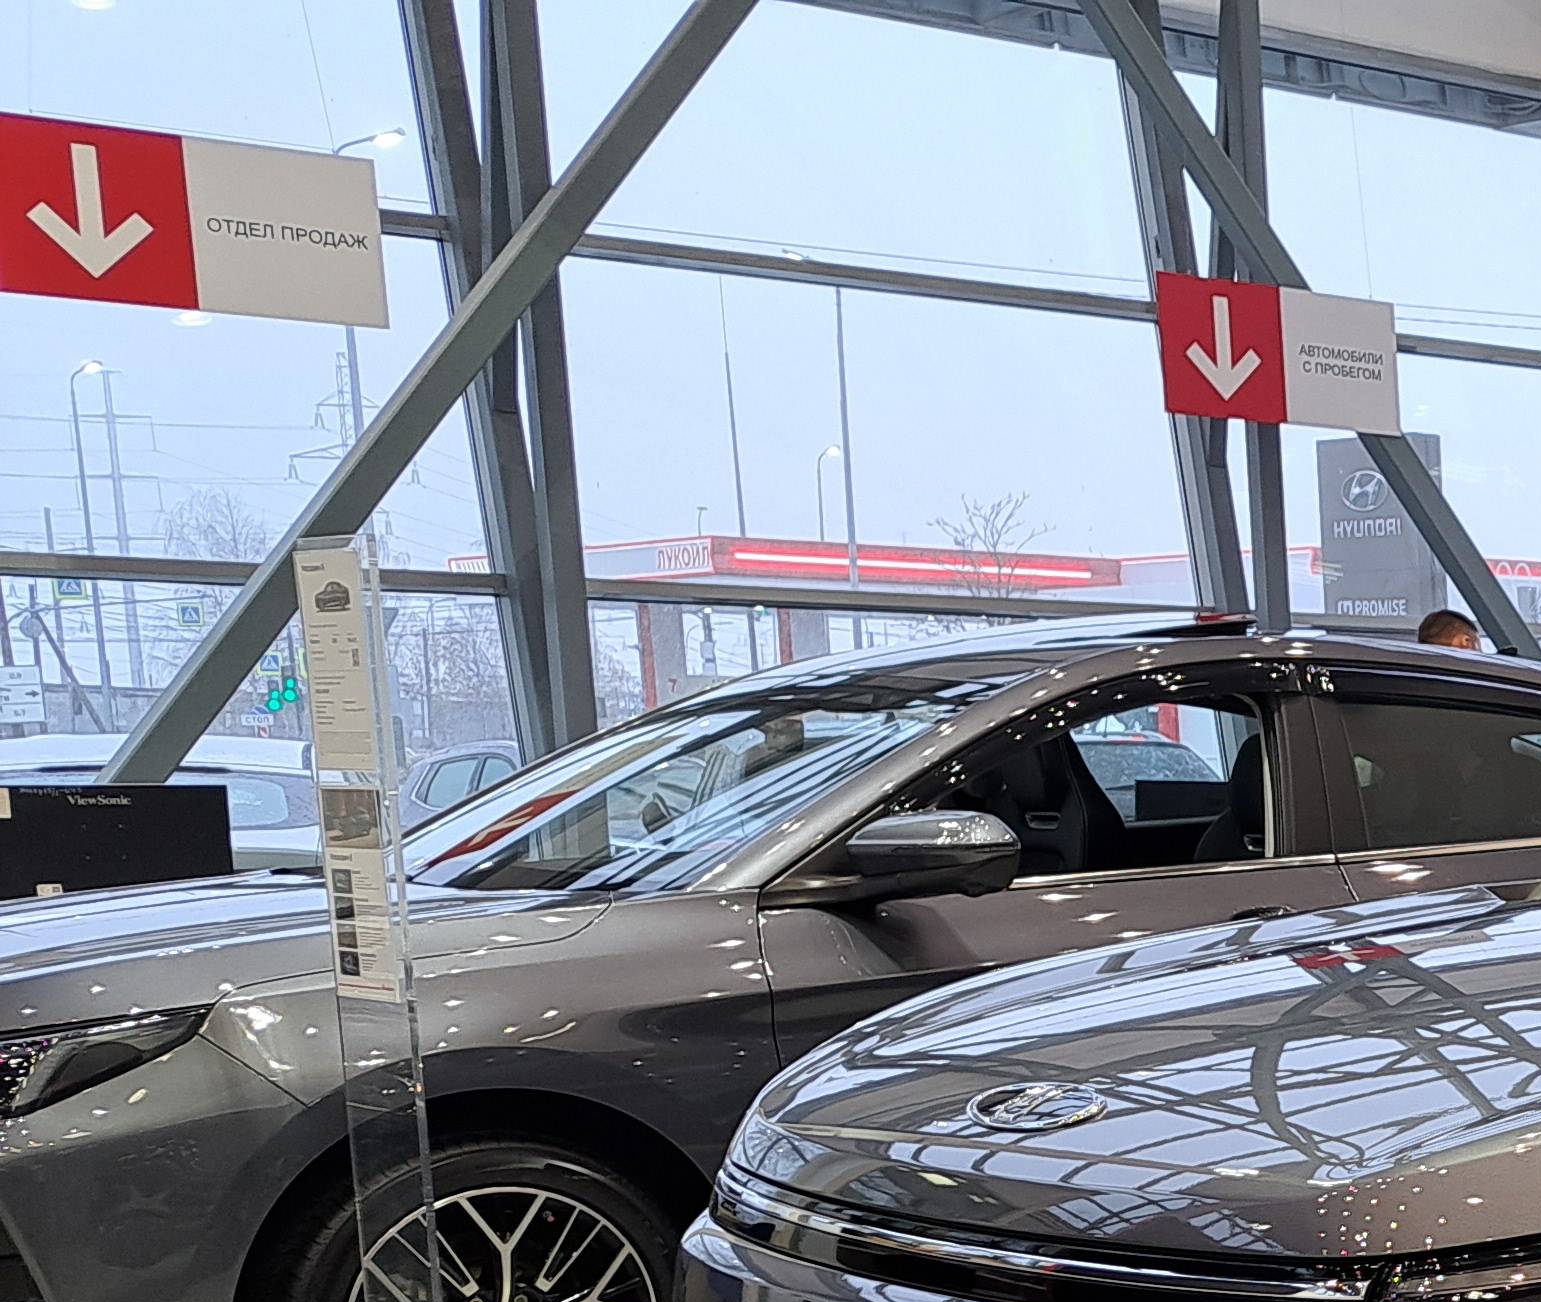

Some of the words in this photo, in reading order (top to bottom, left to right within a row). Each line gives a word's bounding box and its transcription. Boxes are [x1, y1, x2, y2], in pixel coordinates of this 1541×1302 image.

[206, 216, 276, 240] ОТДЕЛ
[280, 225, 370, 251] ПРОДАЖ
[1298, 343, 1384, 366] АВТОМОБИЛИ
[1302, 360, 1312, 374] С
[1314, 361, 1382, 382] ПРОБЕГОМ
[1333, 517, 1402, 539] HYUNDAI
[1354, 599, 1408, 616] PROMISE
[66, 794, 133, 806] ViewSonic
